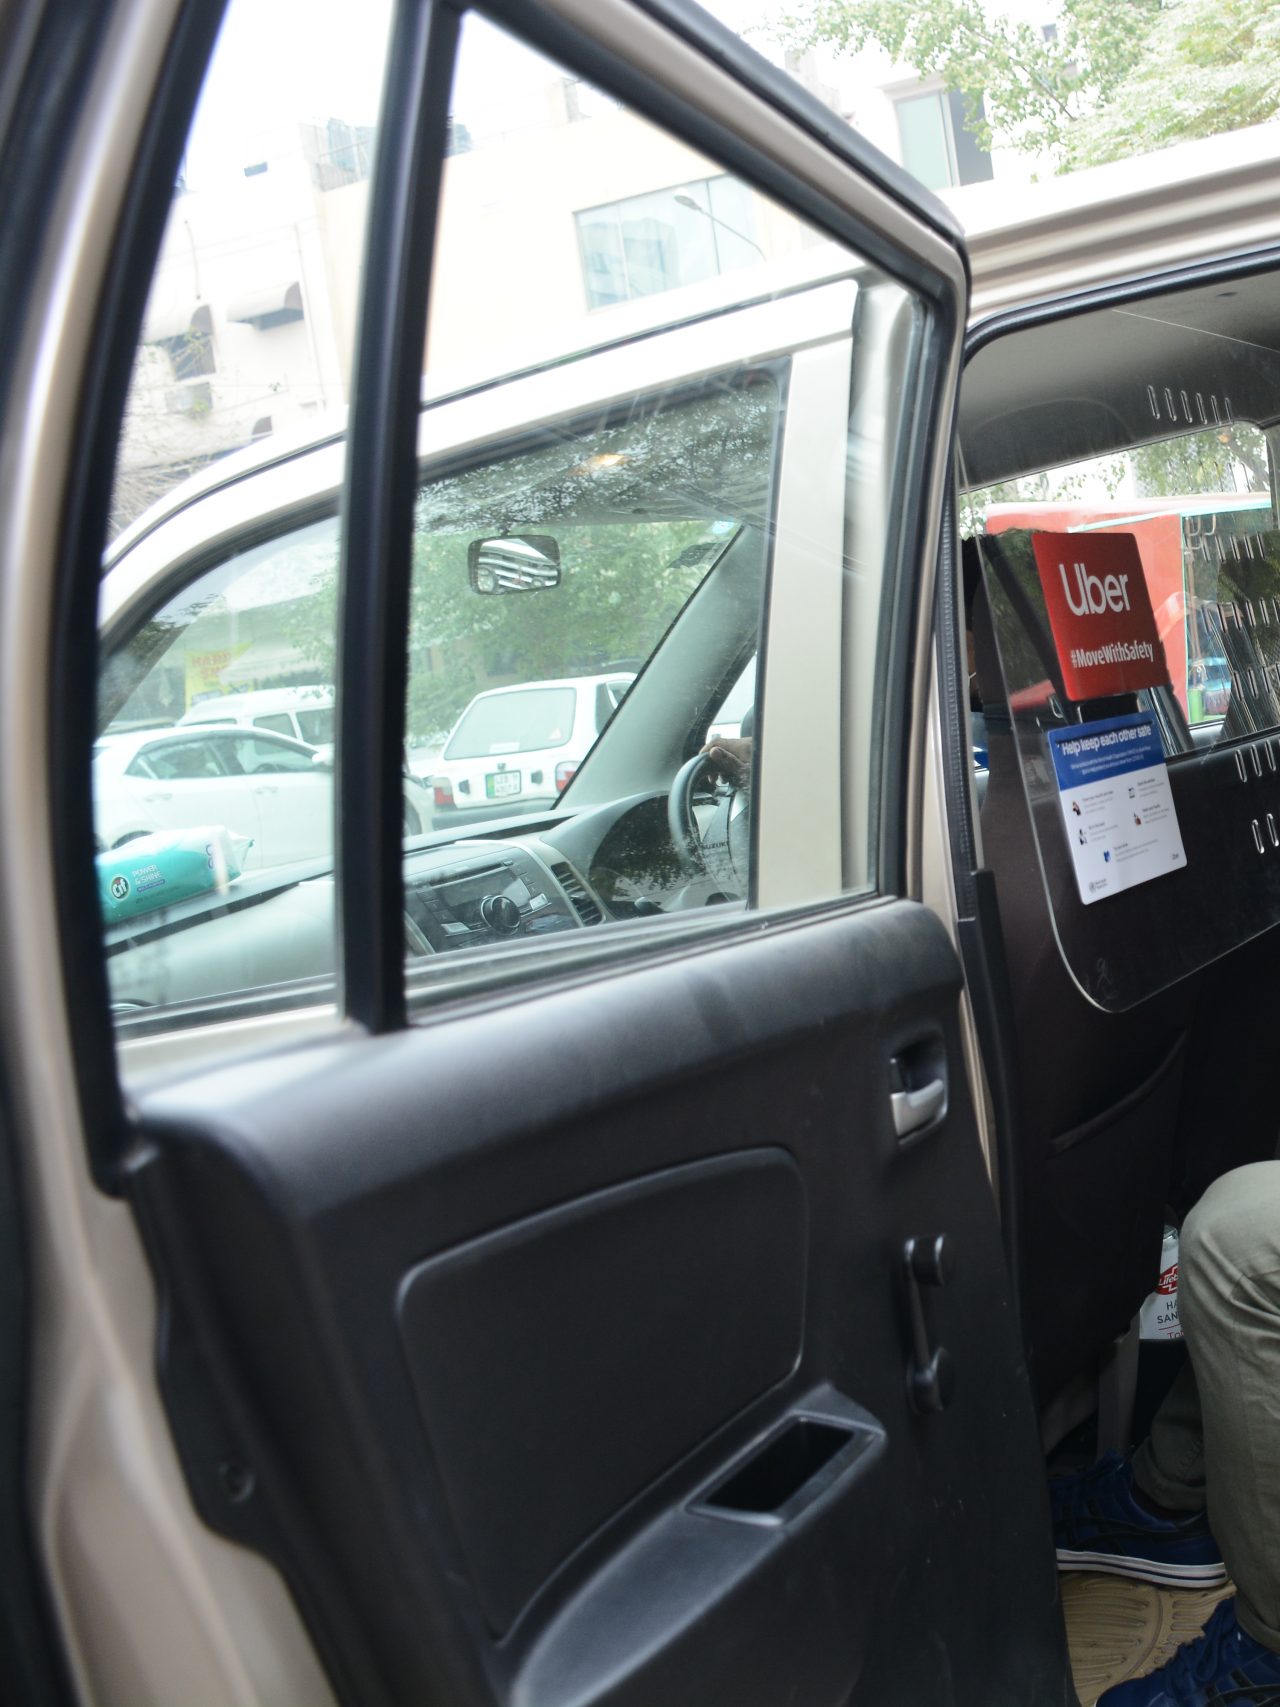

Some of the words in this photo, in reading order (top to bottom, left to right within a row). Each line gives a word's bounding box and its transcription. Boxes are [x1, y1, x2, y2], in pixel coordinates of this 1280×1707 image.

[1058, 562, 1131, 616] Uber
[1070, 640, 1154, 668] #MoveWithSafety
[1062, 740, 1081, 756] Help
[1080, 736, 1100, 752] keep
[1100, 732, 1119, 747] each
[1118, 728, 1138, 743] other
[1137, 724, 1152, 738] safe
[131, 864, 158, 877] POWER
[141, 870, 163, 882] SHINE
[112, 878, 128, 898] Cif
[1156, 1312, 1179, 1324] SAN
